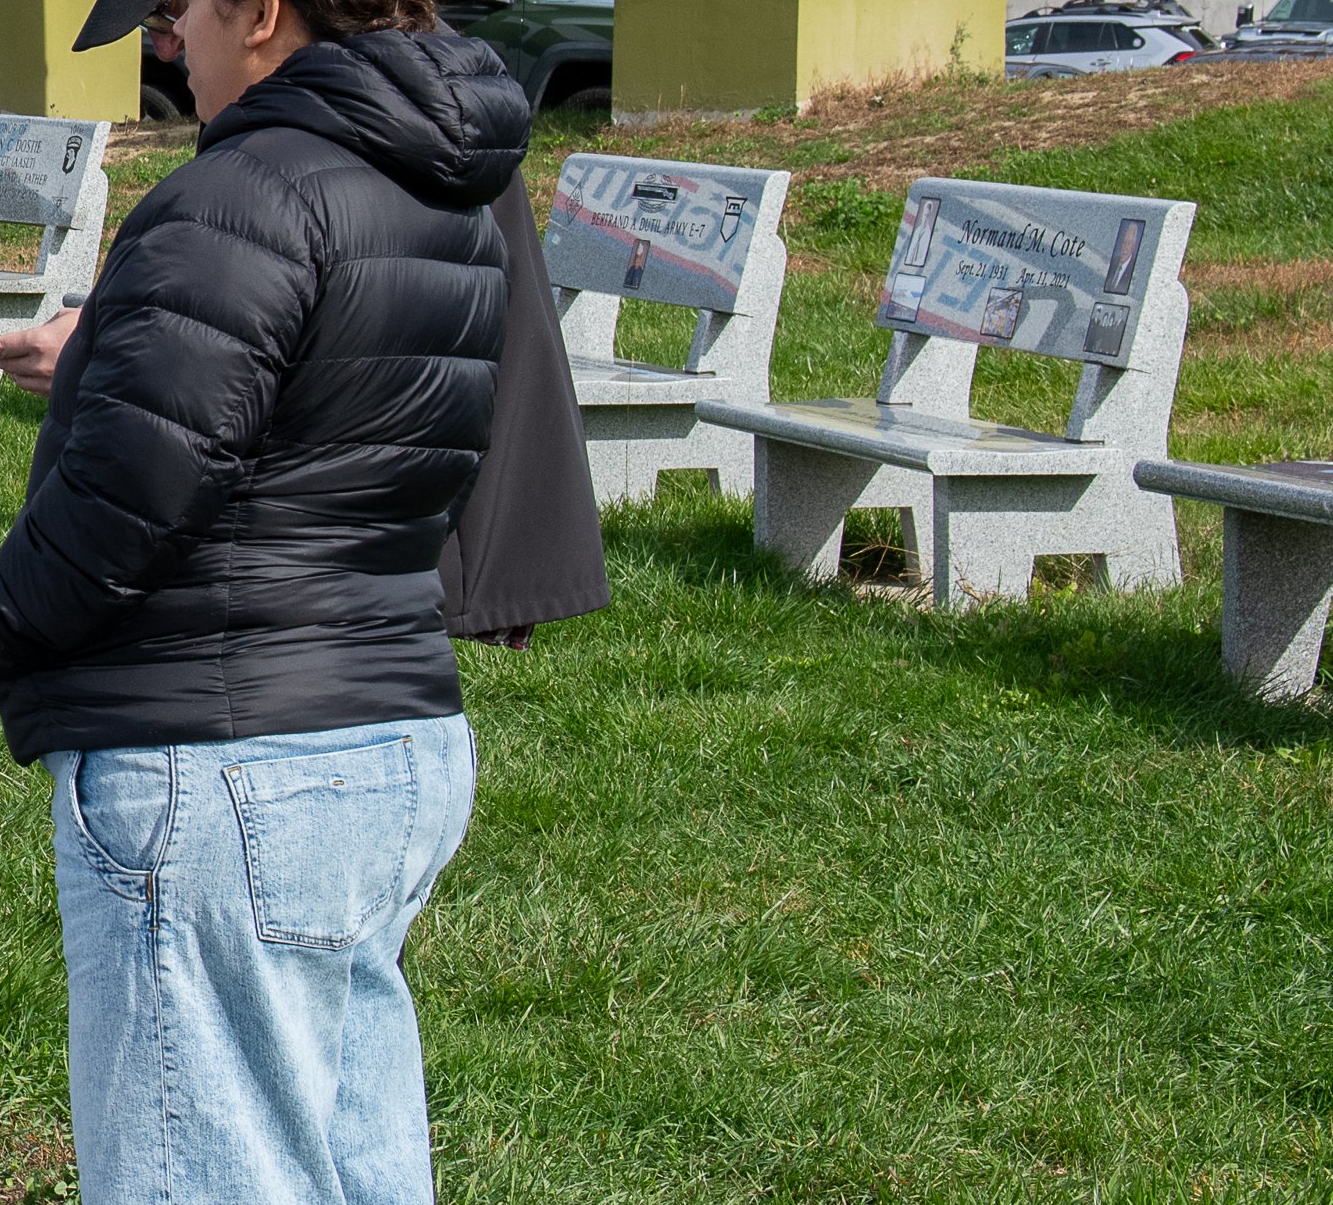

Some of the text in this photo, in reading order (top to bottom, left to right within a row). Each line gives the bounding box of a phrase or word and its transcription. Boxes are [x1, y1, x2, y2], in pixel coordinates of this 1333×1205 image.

[18, 124, 28, 135] OF
[6, 139, 13, 151] C
[15, 139, 42, 153] DOSTIE
[24, 173, 48, 186] FATHER
[591, 212, 706, 238] BERTRAND A DUTIL ARMY E-7
[958, 220, 1086, 258] Normand M. Cote
[956, 260, 1071, 289] Sept. 21, 1931 Apr. 11, 2021
